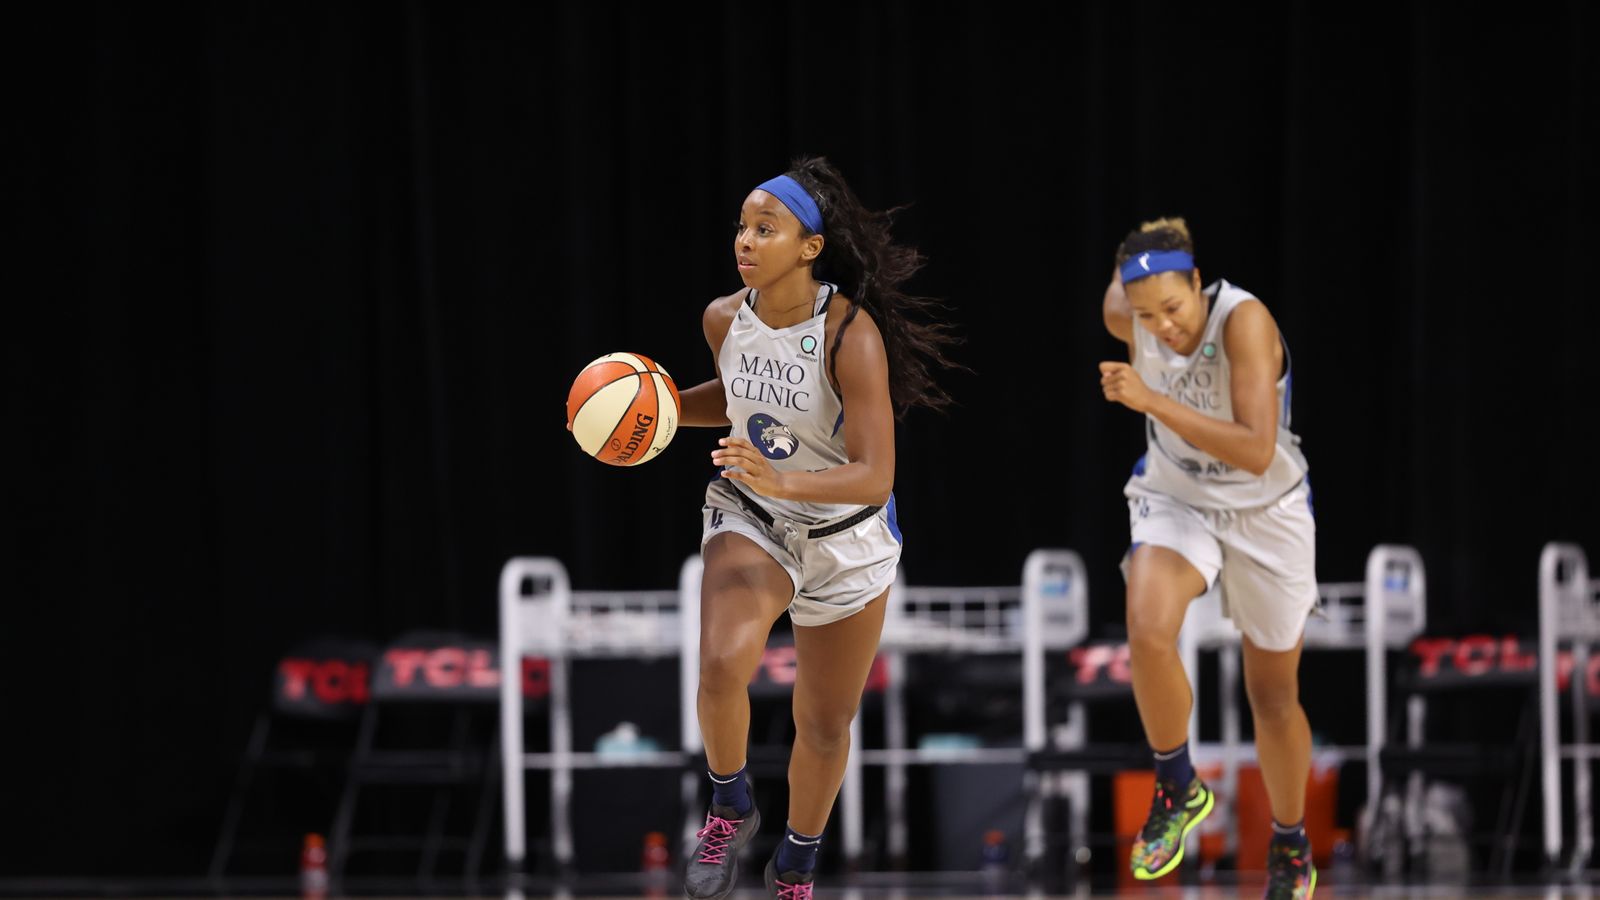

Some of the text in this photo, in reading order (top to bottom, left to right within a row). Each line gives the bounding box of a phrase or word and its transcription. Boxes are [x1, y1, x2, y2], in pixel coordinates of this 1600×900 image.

[739, 353, 805, 385] MAYO
[731, 377, 810, 412] CLINIC
[711, 508, 723, 530] 4
[384, 646, 502, 689] TCL
[1409, 634, 1537, 678] TCL
